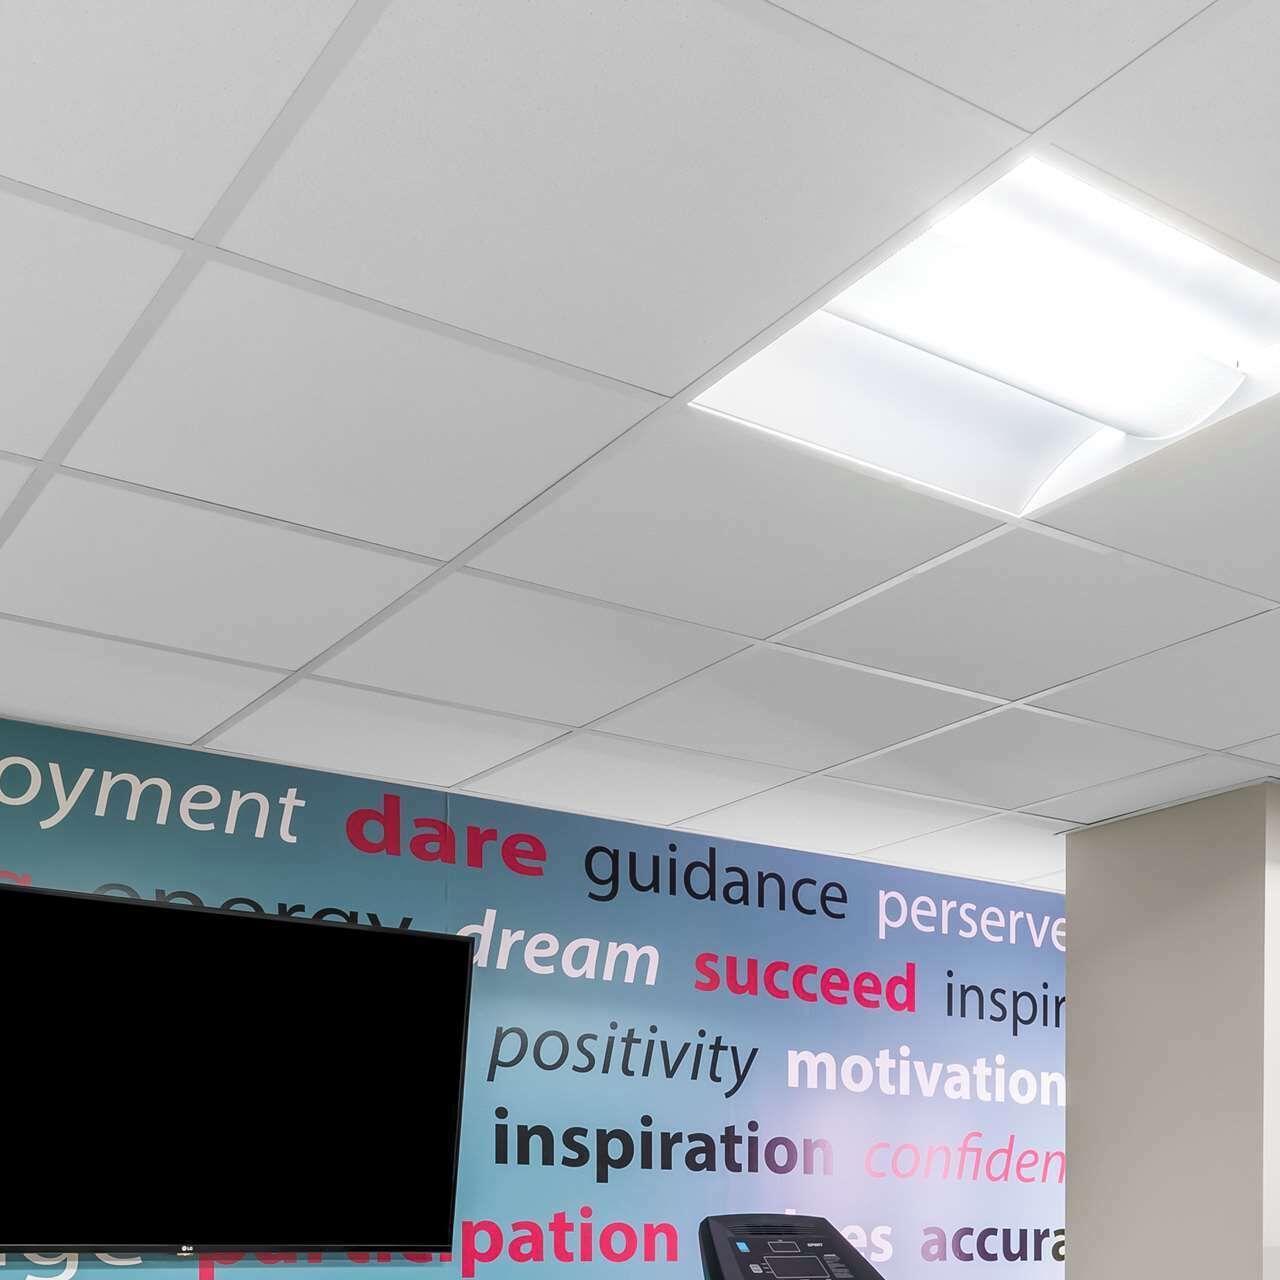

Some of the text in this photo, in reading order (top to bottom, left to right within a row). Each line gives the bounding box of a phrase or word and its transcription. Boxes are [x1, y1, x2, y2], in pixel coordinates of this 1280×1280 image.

[345, 795, 548, 876] dare
[584, 843, 849, 919] guidance
[457, 908, 660, 986] dream
[694, 952, 917, 1013] succeed
[487, 1021, 759, 1098] positivity
[786, 1045, 1066, 1107] motivation
[494, 1107, 835, 1183] inspiration
